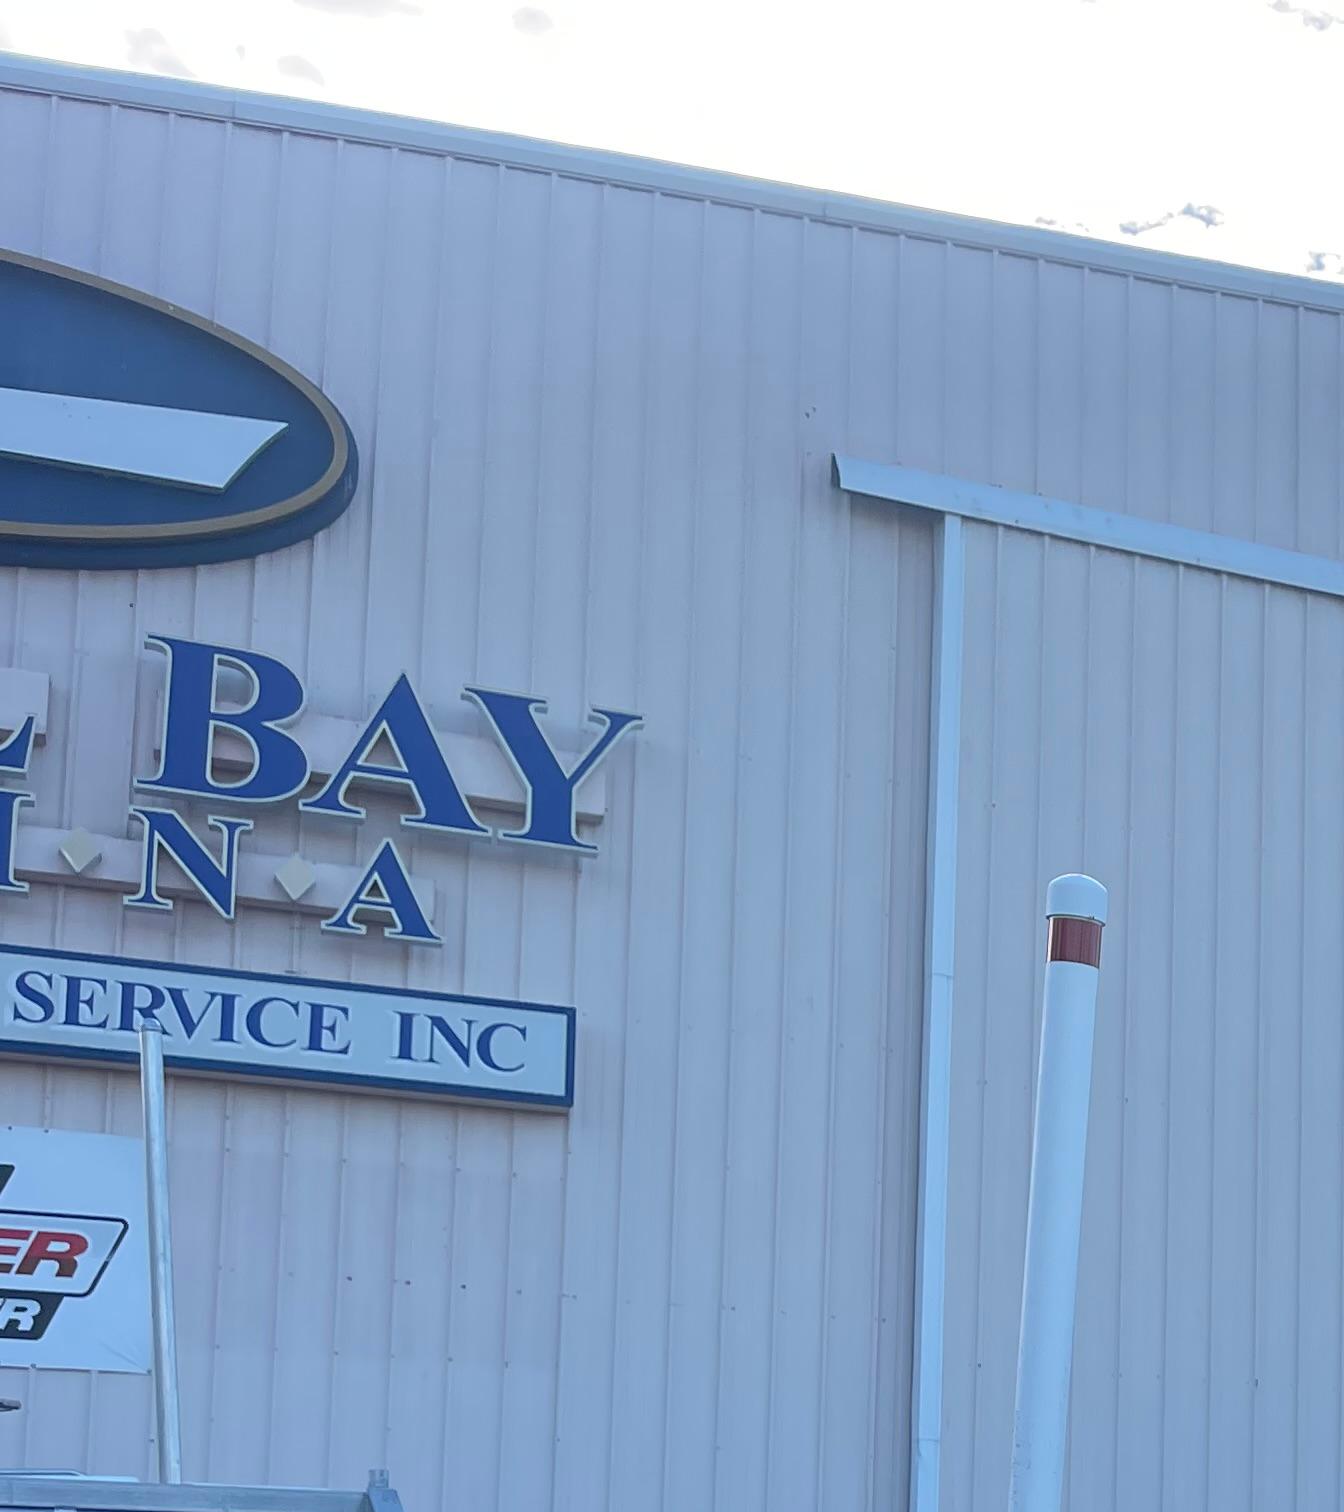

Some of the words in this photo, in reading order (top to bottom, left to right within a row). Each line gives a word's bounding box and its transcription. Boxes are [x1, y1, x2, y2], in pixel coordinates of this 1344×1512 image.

[133, 632, 645, 858] BAY
[10, 969, 352, 1056] SERVICE
[389, 1009, 529, 1074] INC
